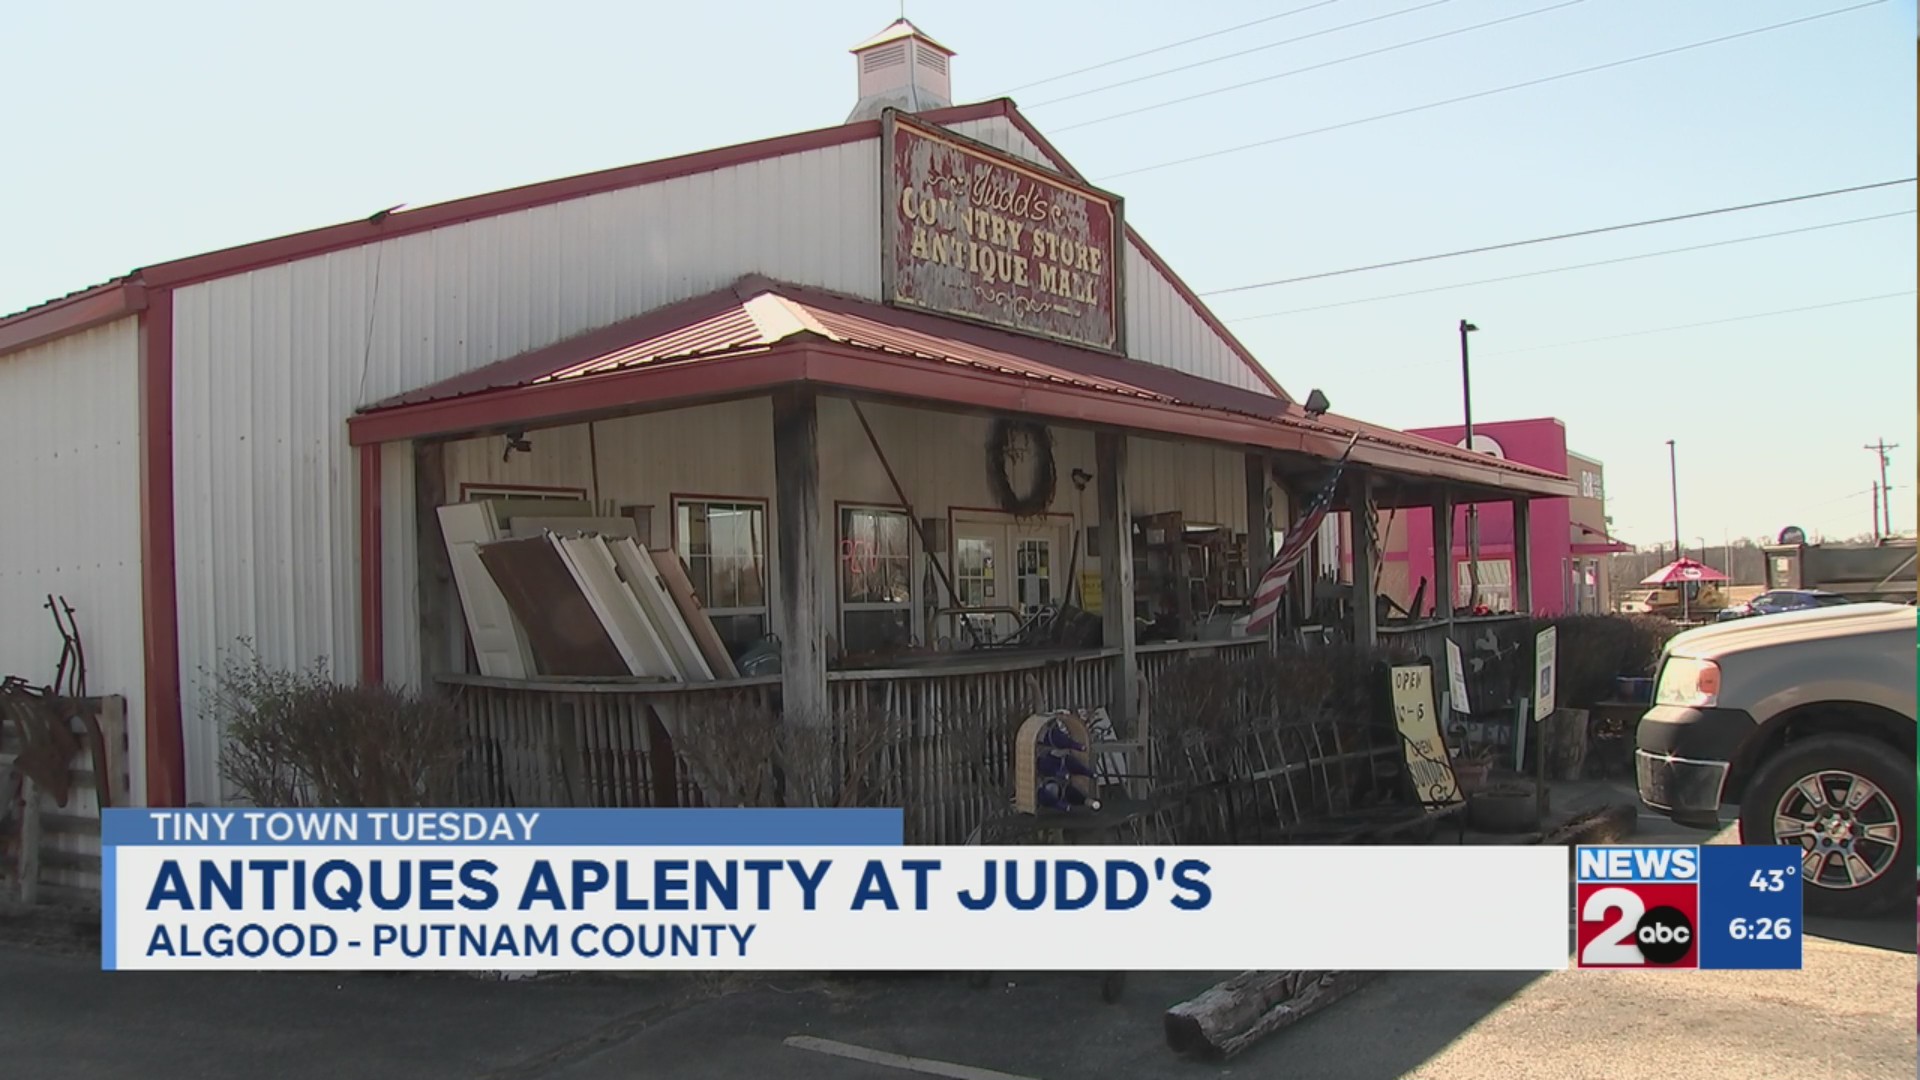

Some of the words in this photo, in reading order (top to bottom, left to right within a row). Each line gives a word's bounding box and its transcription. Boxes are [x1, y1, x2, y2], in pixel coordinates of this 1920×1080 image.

[971, 165, 1047, 222] Judd's
[911, 227, 1029, 286] ANTIQUE
[1039, 262, 1099, 306] MALL
[1032, 229, 1103, 276] STORE
[840, 537, 881, 574] PEN
[1395, 671, 1423, 691] OPEN
